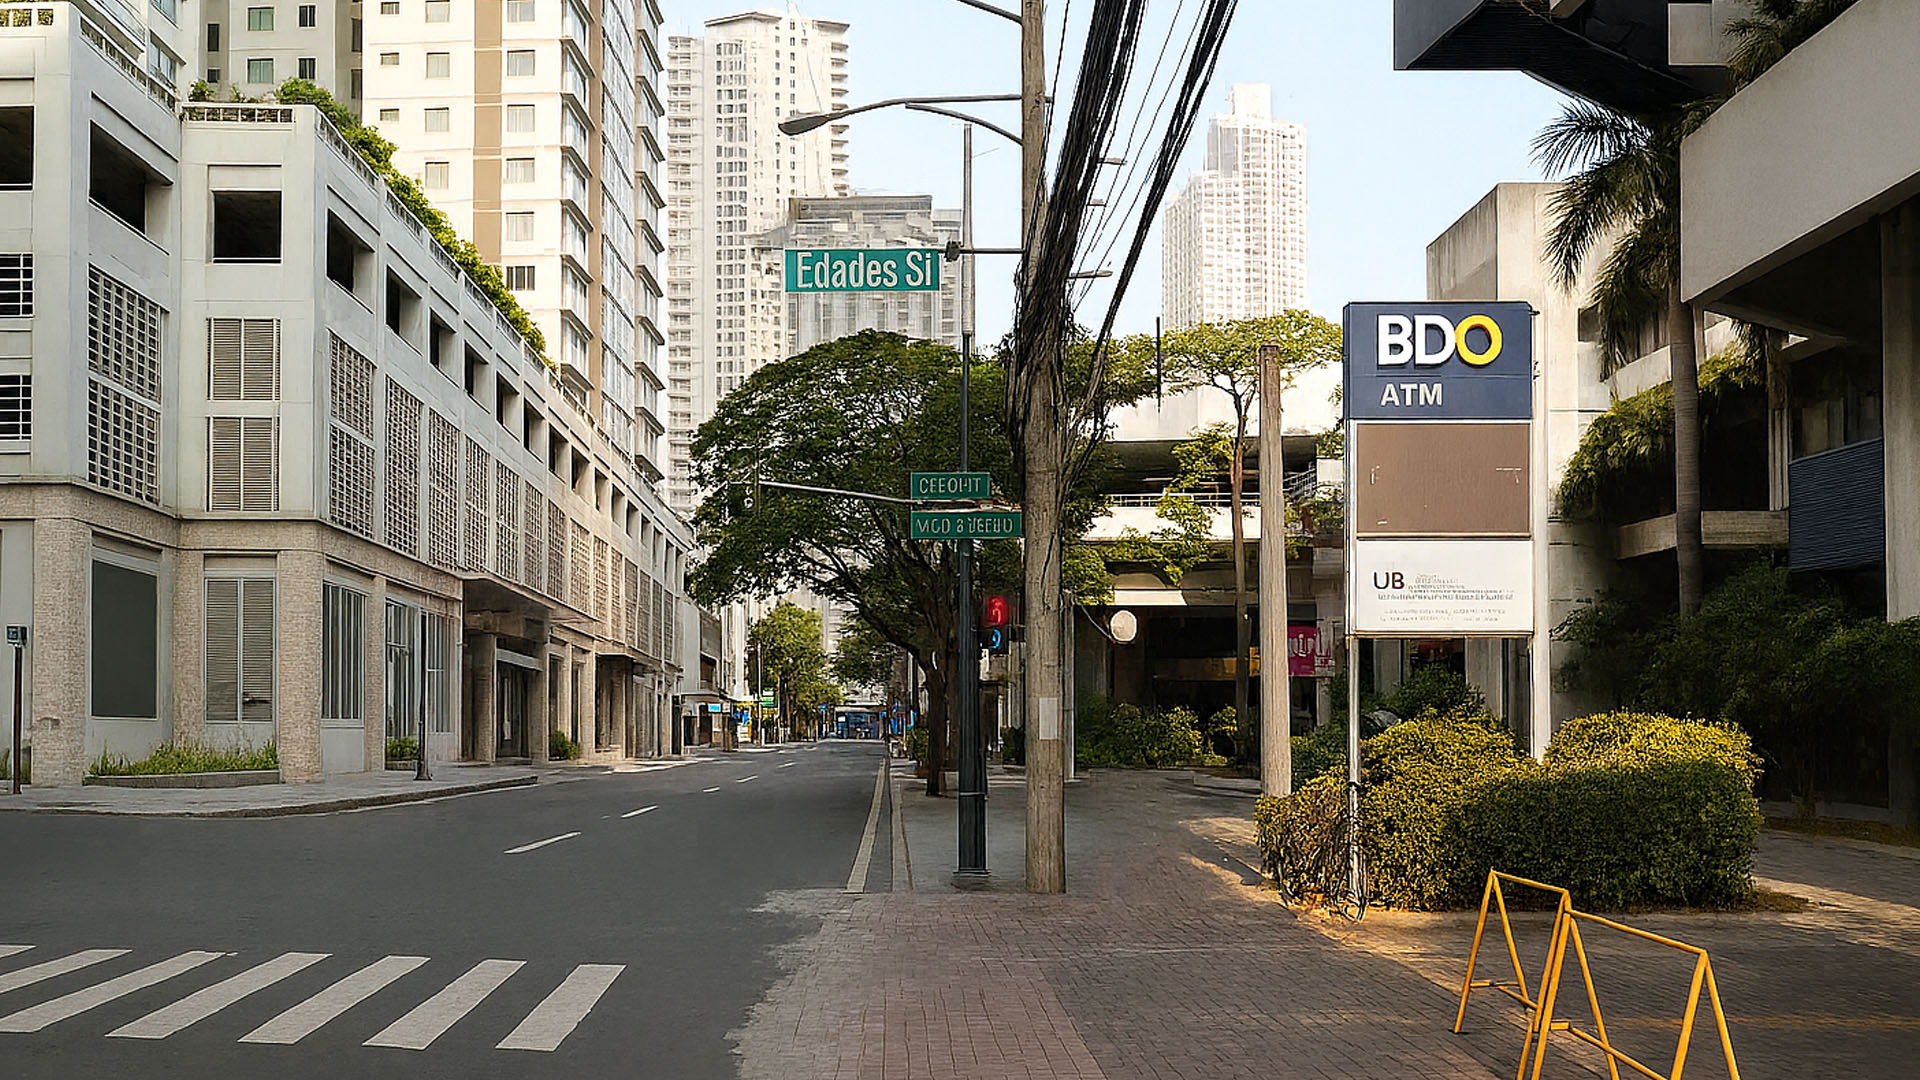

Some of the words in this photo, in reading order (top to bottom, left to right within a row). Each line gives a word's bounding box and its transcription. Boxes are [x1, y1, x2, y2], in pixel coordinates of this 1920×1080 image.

[796, 251, 898, 289] Edades
[1376, 314, 1503, 366] BDO
[1380, 383, 1443, 407] ATM
[1373, 571, 1405, 590] UB
